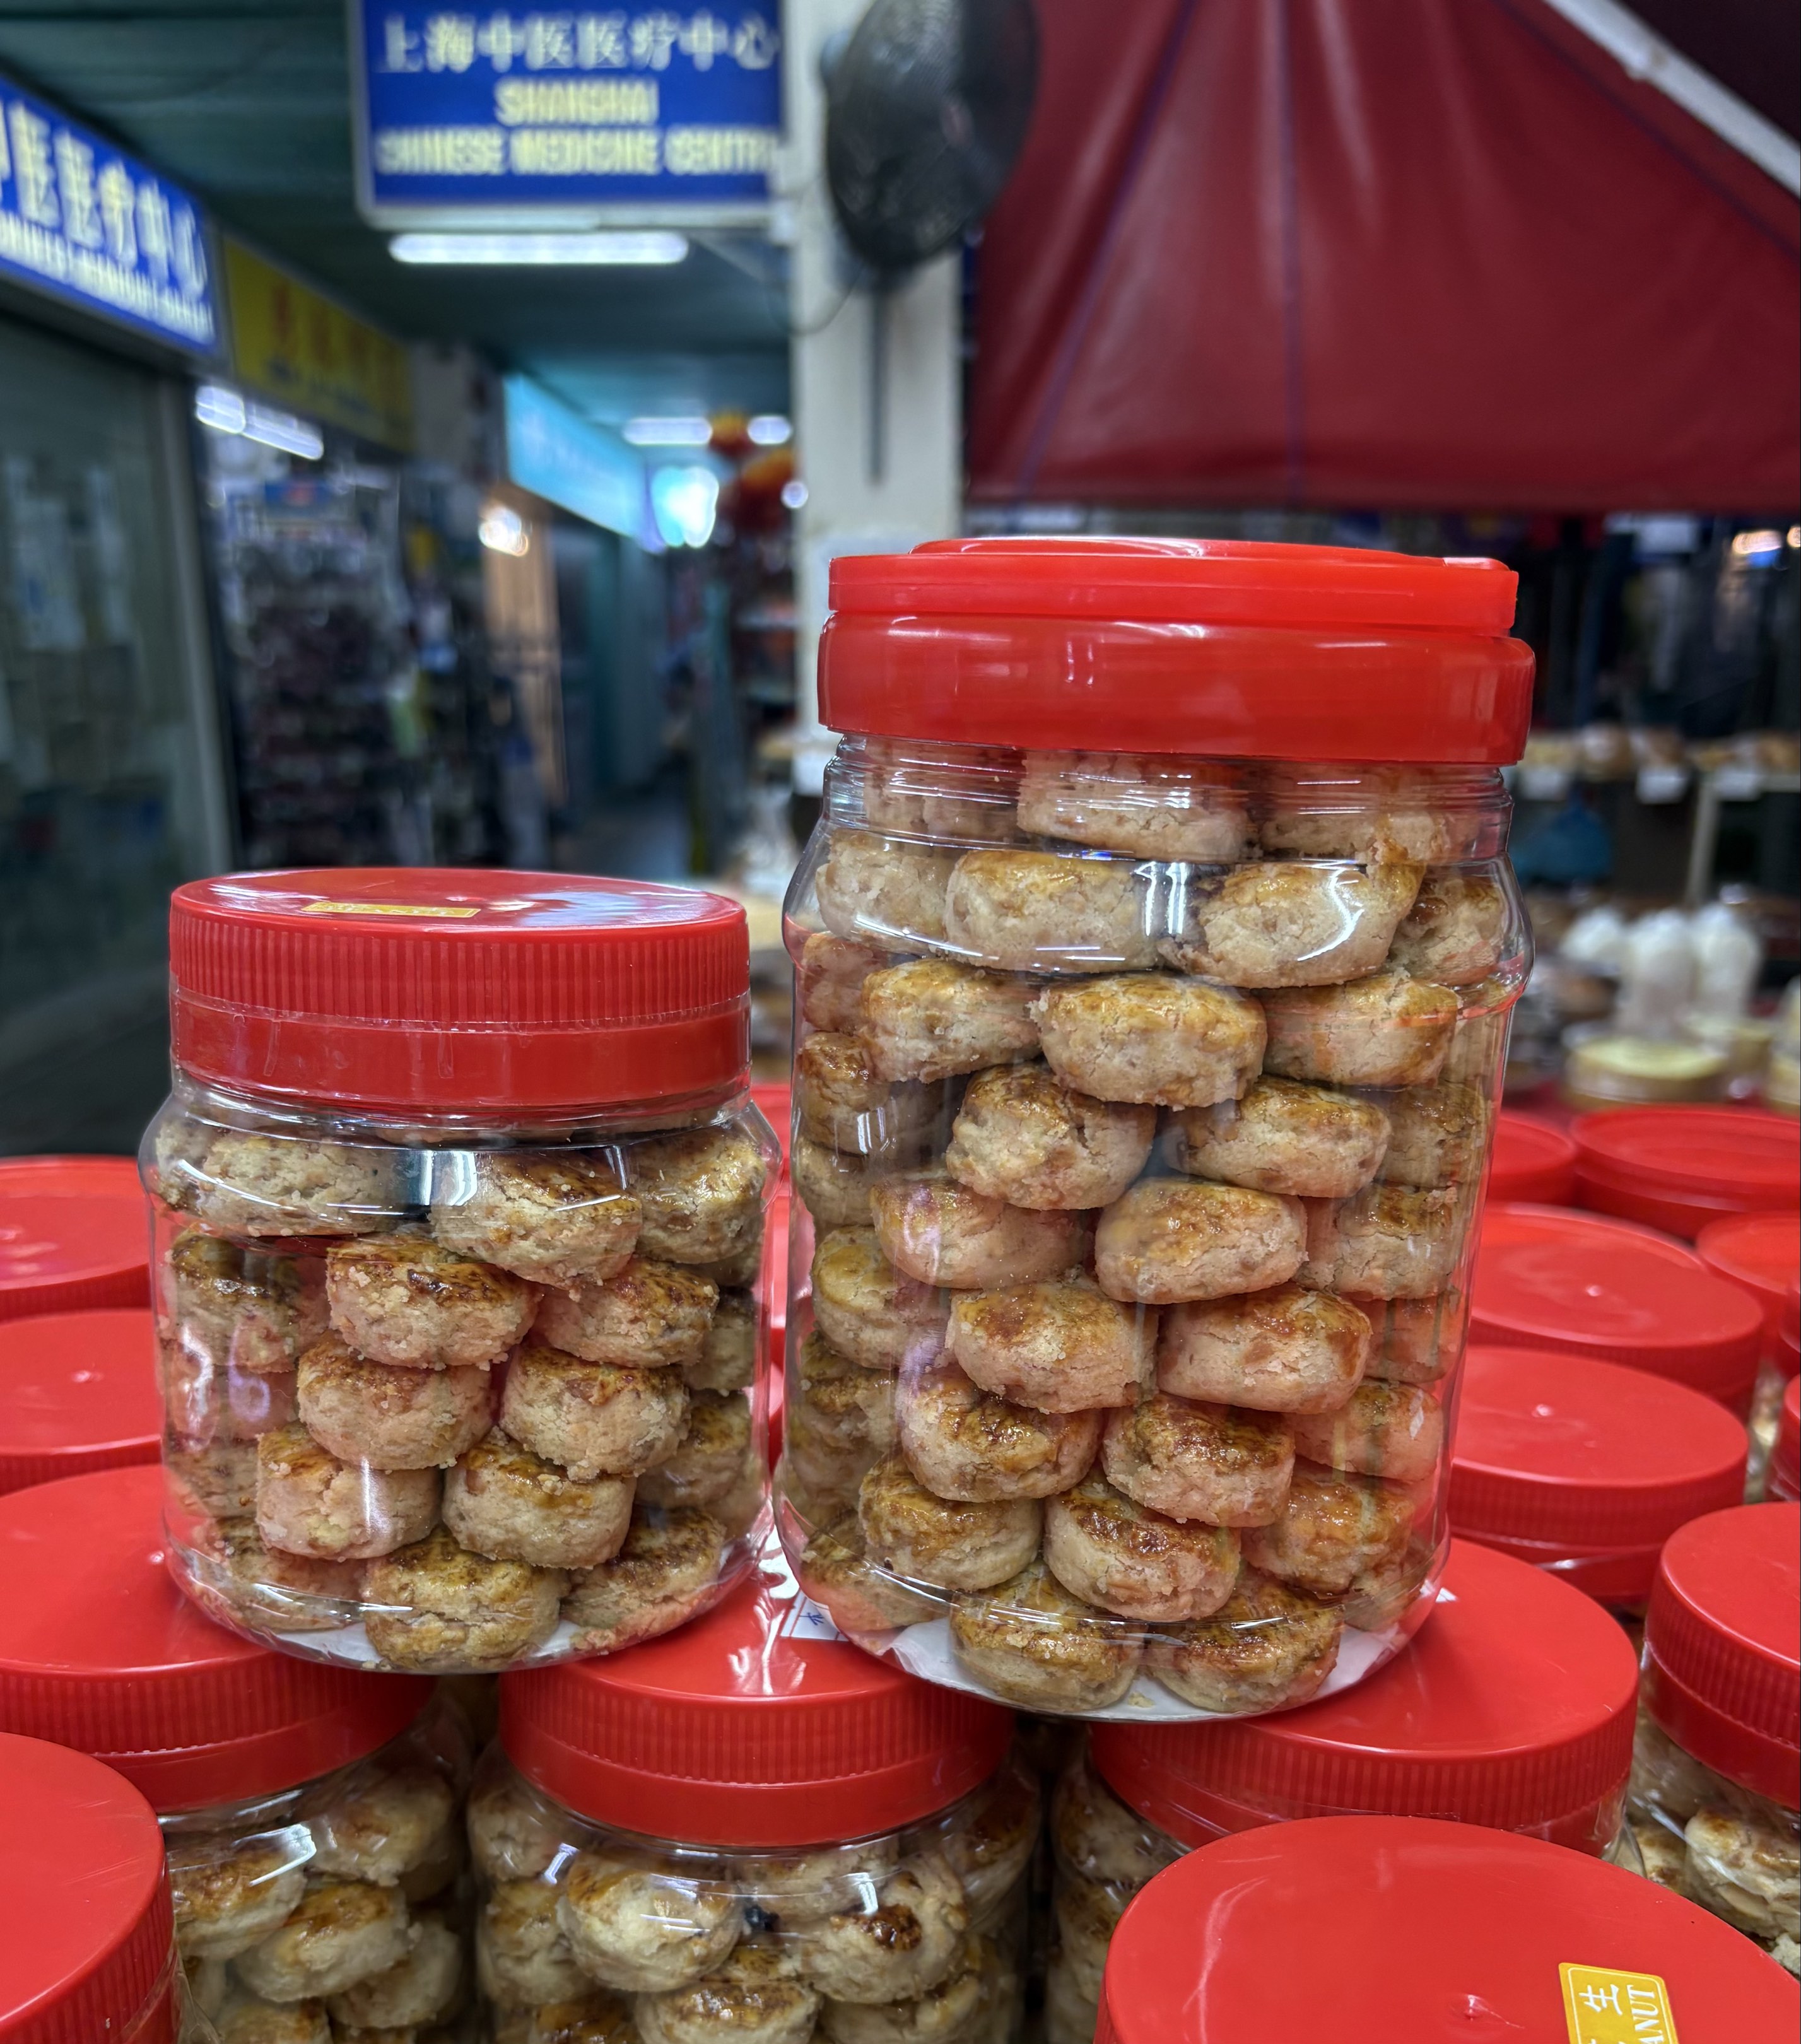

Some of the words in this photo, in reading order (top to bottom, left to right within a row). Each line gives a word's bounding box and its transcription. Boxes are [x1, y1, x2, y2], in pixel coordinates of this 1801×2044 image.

[375, 11, 778, 73] 上海中医医疗中心
[494, 75, 659, 126] SHANGHAI
[509, 127, 662, 175] MEDICINE
[0, 100, 208, 302] 医医疗中心
